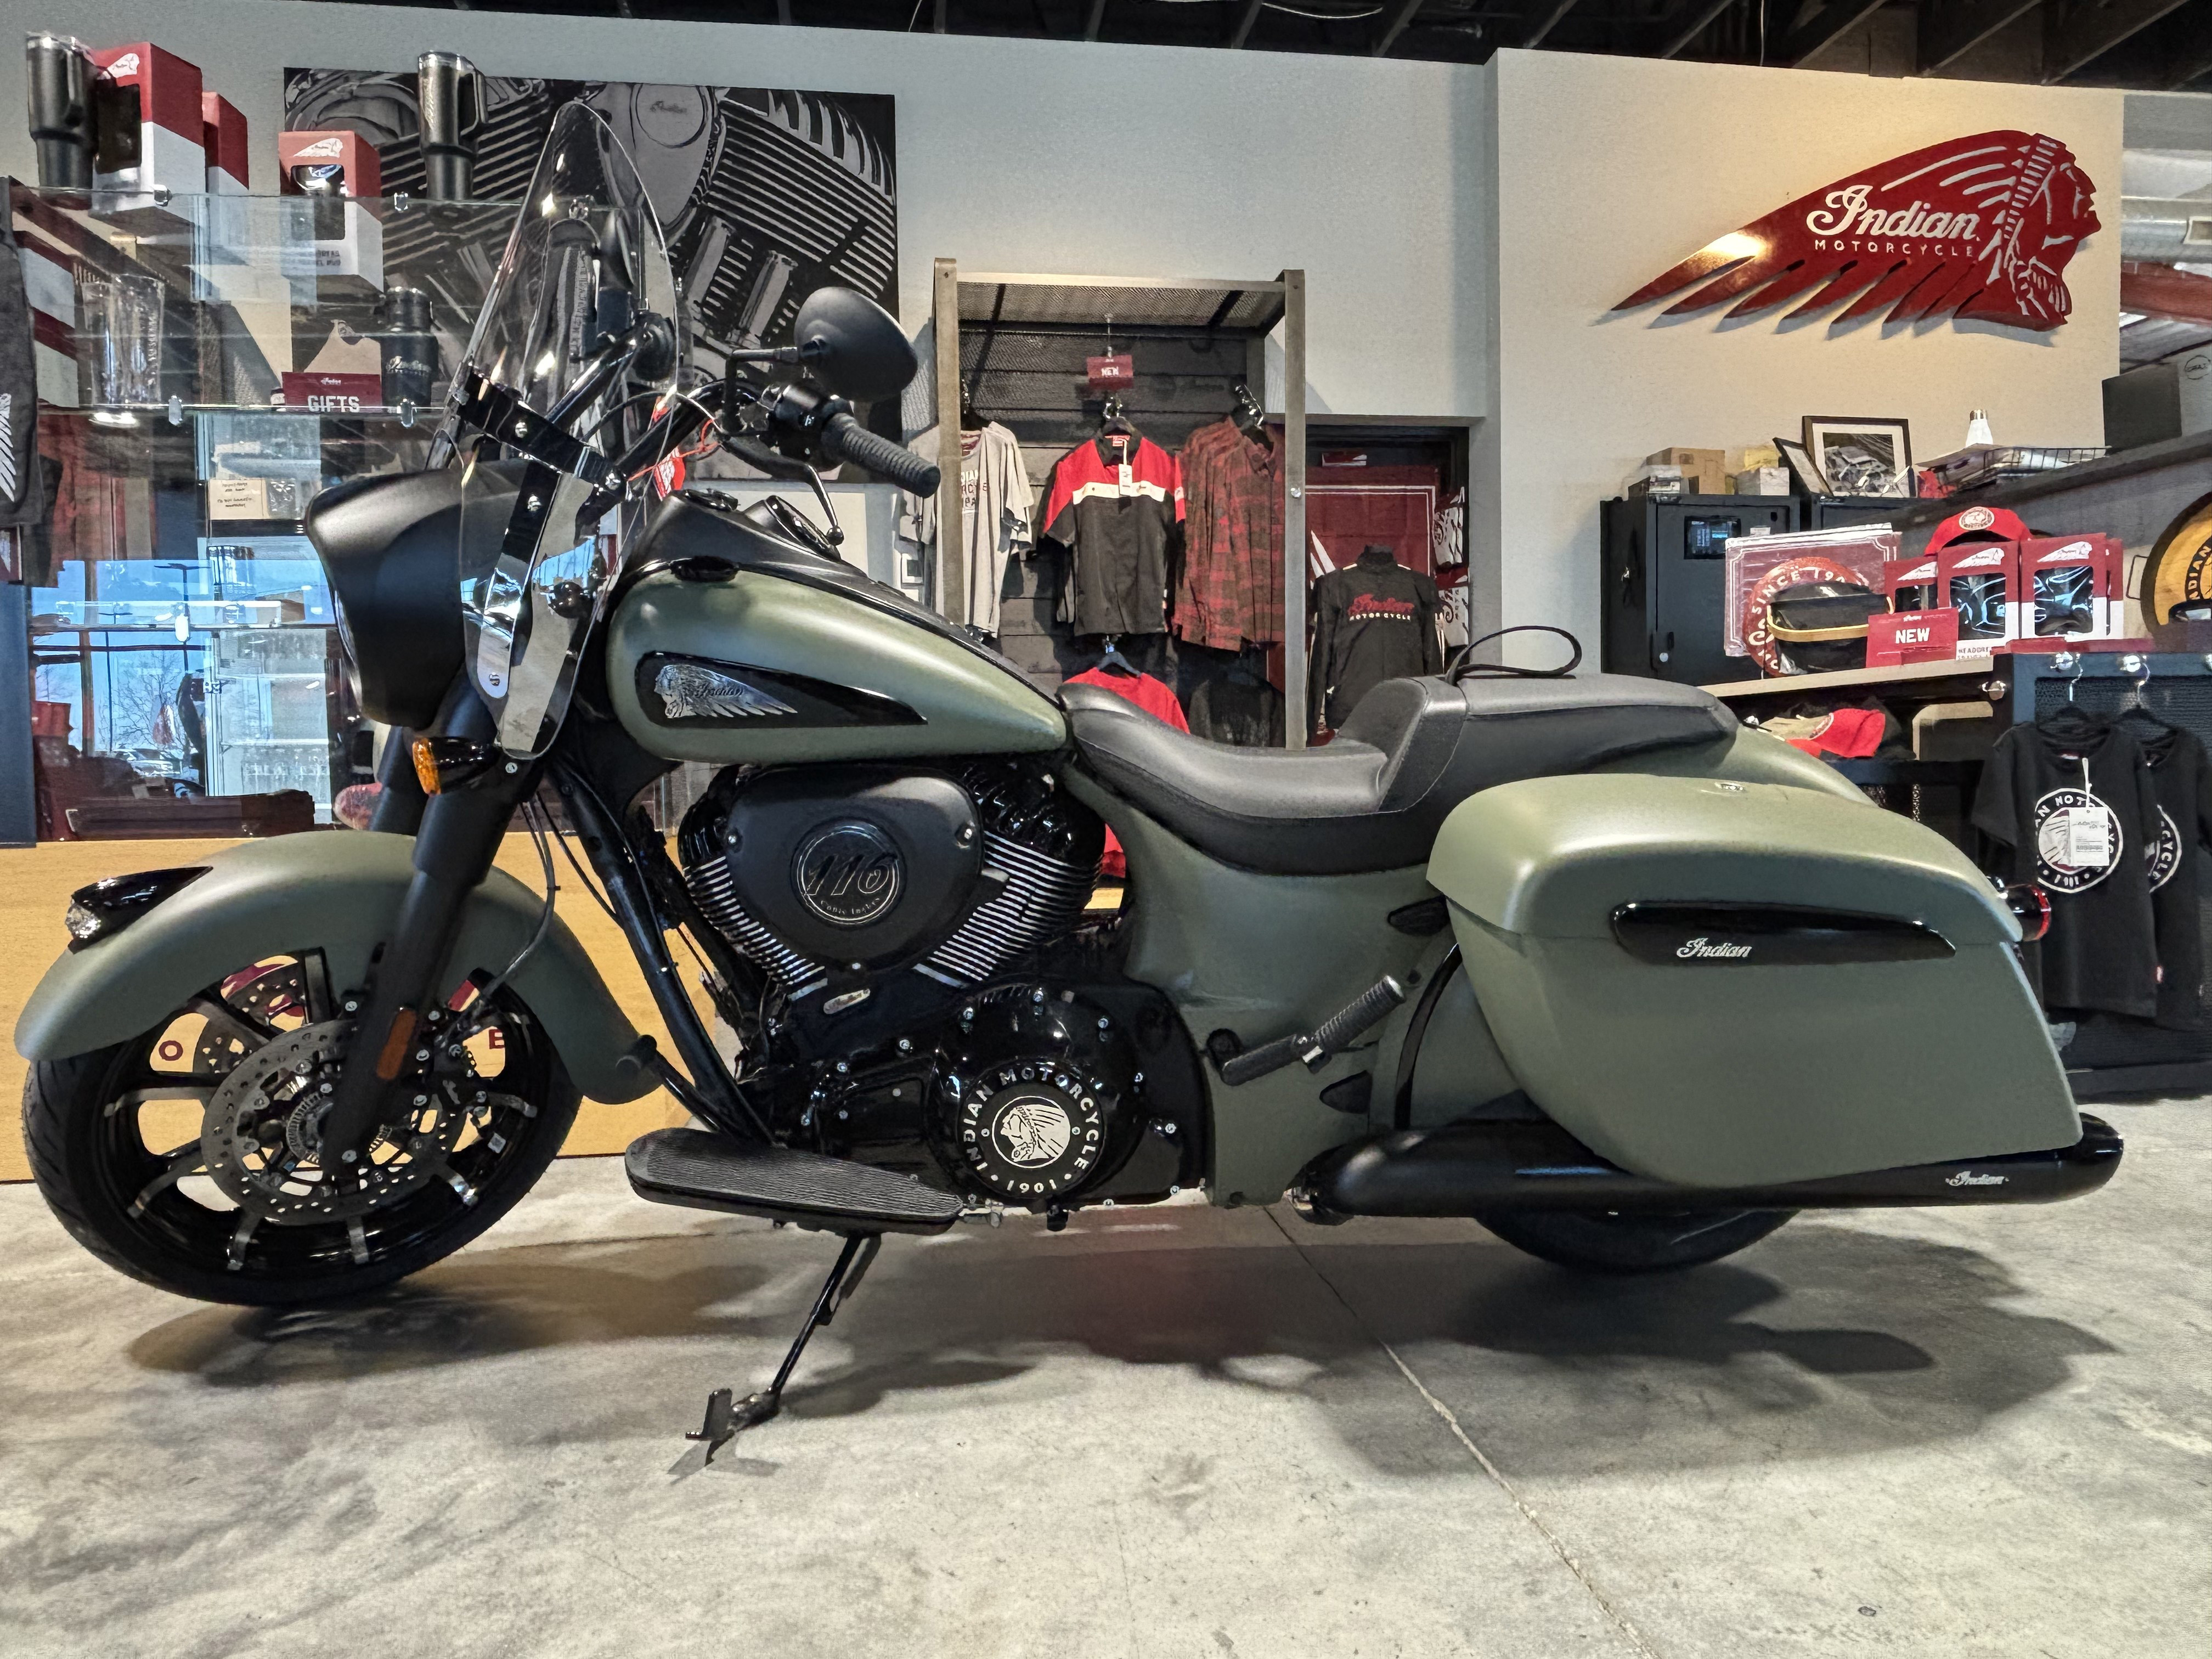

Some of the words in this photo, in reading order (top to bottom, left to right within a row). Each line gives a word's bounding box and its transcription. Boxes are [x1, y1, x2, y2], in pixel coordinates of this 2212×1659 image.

[1806, 184, 1980, 240] Indian
[1814, 239, 1974, 257] MOTORCYCLE
[307, 395, 360, 413] GIFTS
[1751, 570, 1802, 615] SINCE
[1895, 627, 1931, 644] NEW
[805, 852, 898, 896] 116
[1676, 937, 1753, 958] Indian
[963, 1084, 994, 1170] INDIAN
[999, 1067, 1100, 1170] MOTORCYCLE
[1006, 1179, 1057, 1194] 1901
